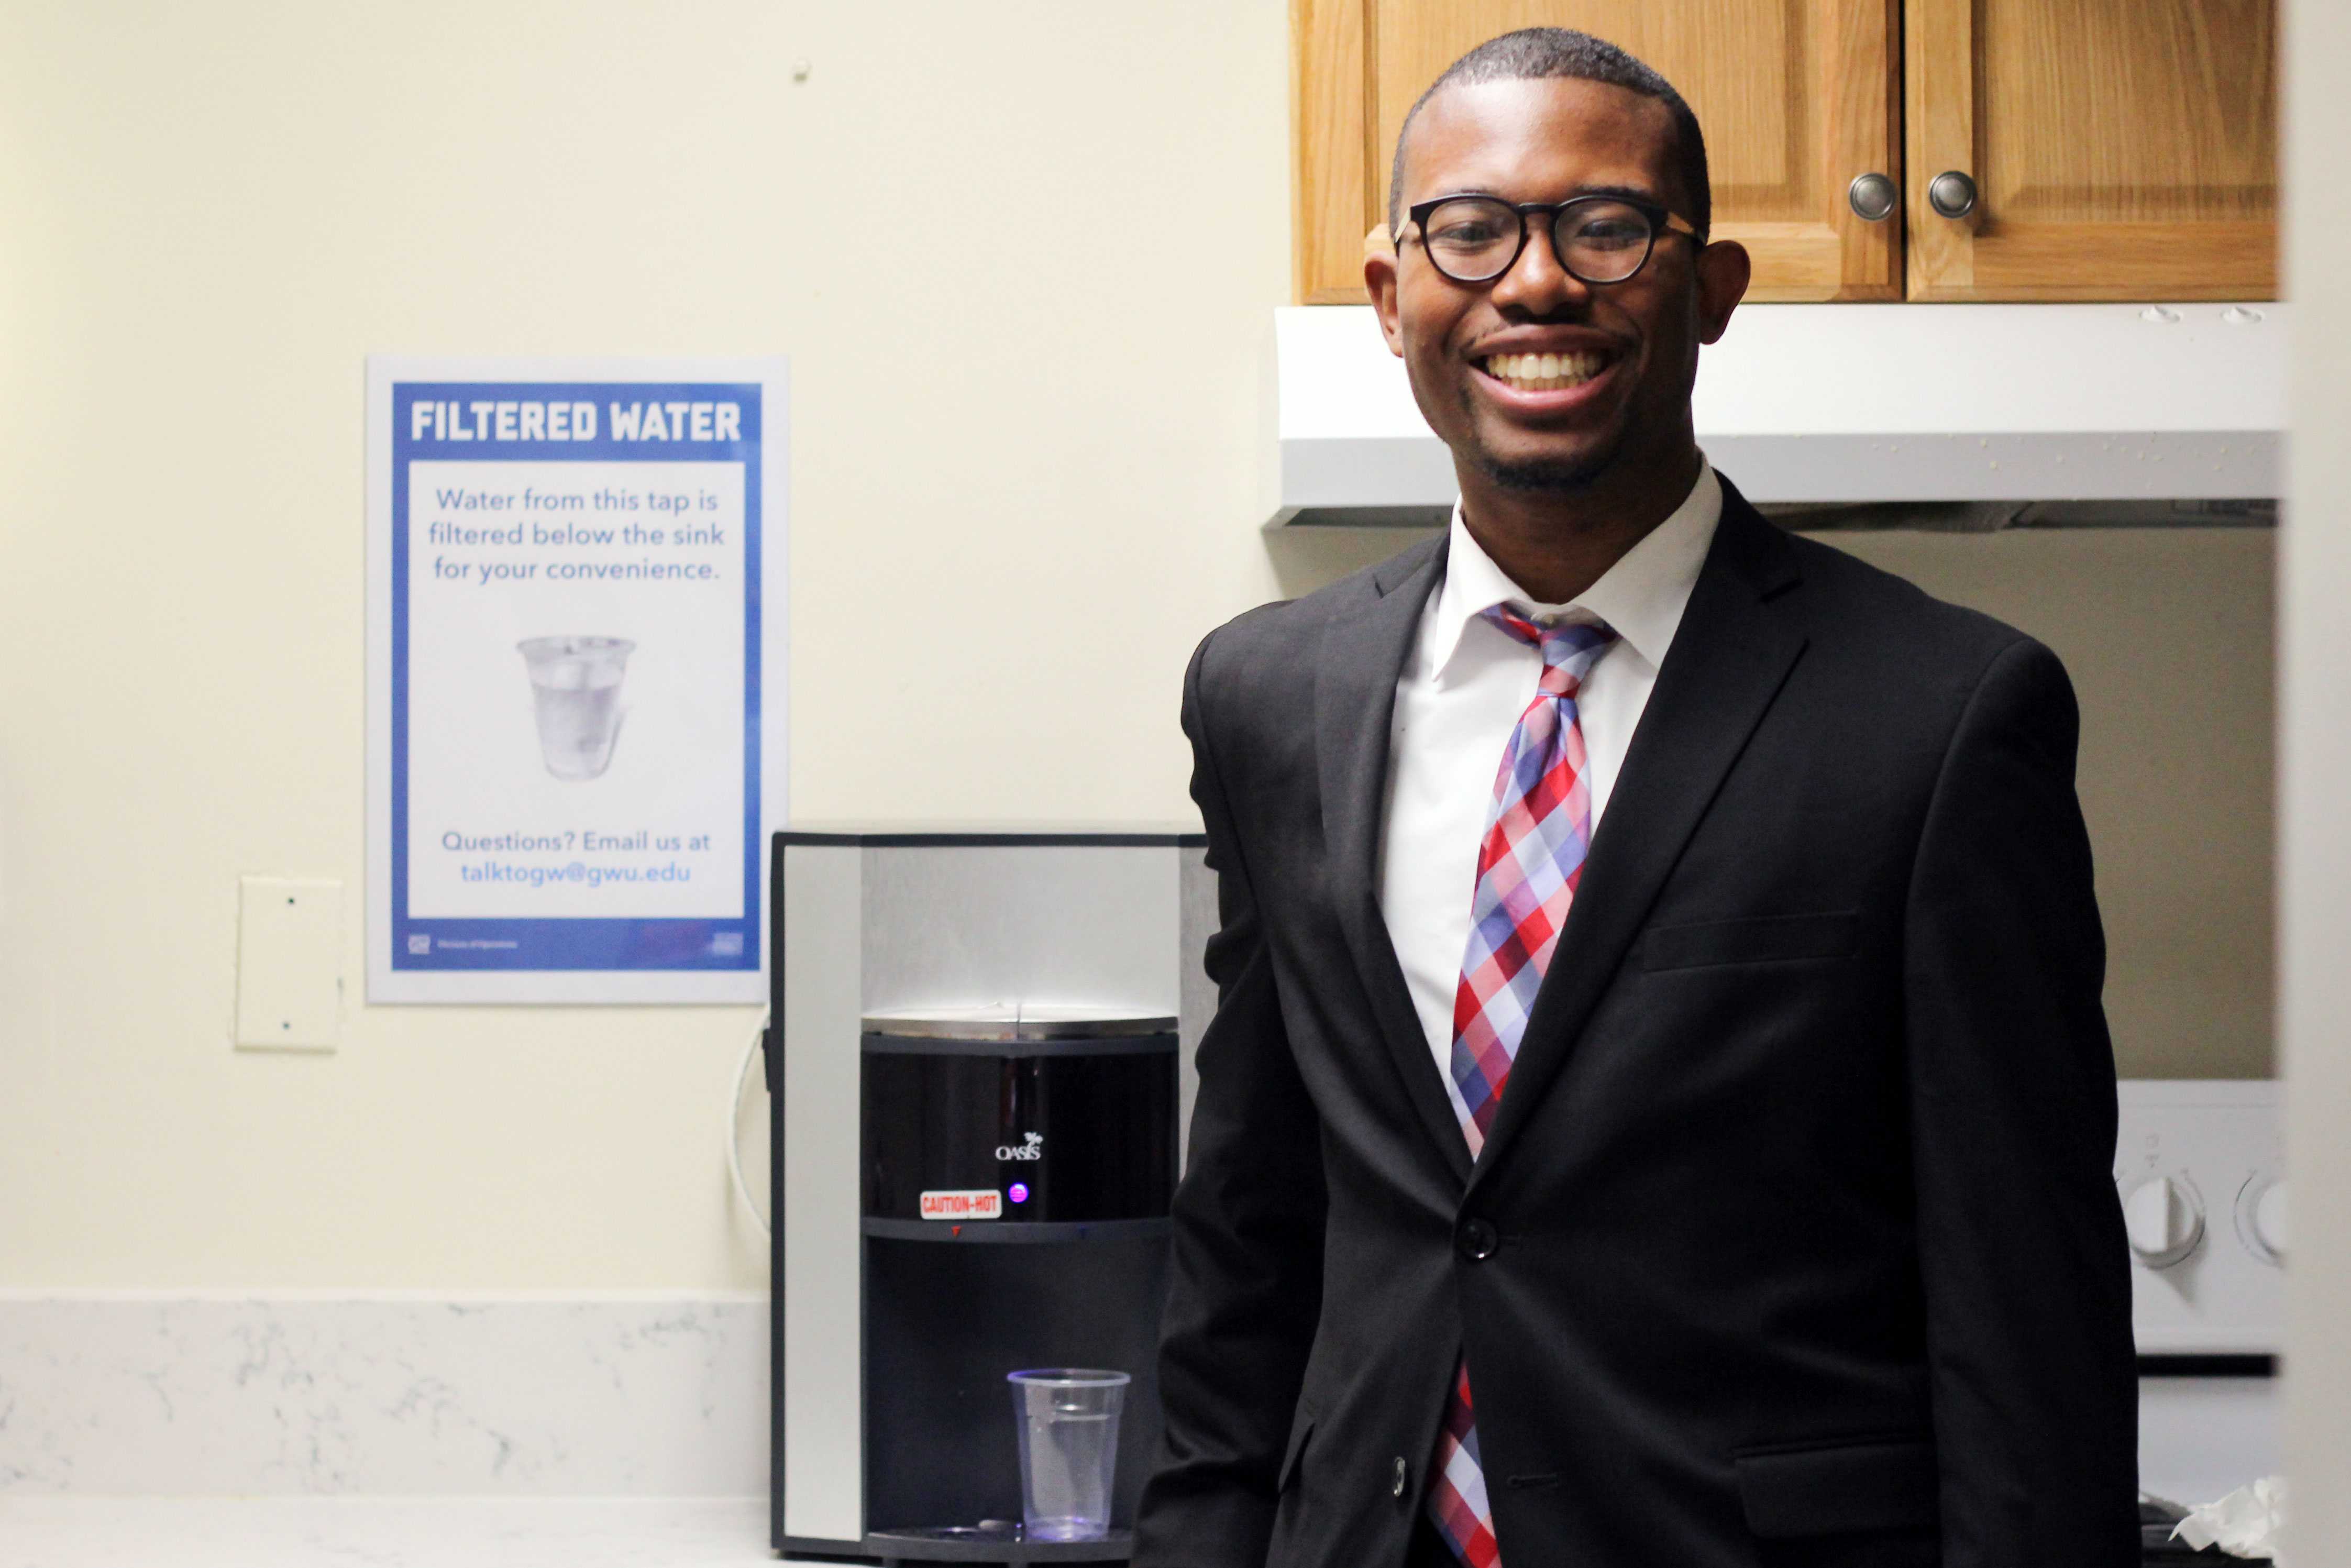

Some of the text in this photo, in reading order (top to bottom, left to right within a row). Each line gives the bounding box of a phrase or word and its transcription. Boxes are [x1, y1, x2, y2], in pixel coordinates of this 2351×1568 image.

[411, 401, 741, 441] FILTERED WATER
[436, 488, 718, 516] Water from this tap is
[428, 522, 724, 545] filtered below the sink
[434, 555, 720, 586] for your convenience.
[441, 830, 711, 852] Questions? Email us at
[461, 862, 691, 888] talktogw@gwu.edu
[996, 1145, 1041, 1161] OASIS
[923, 1196, 997, 1213] CAUTION-HOT
